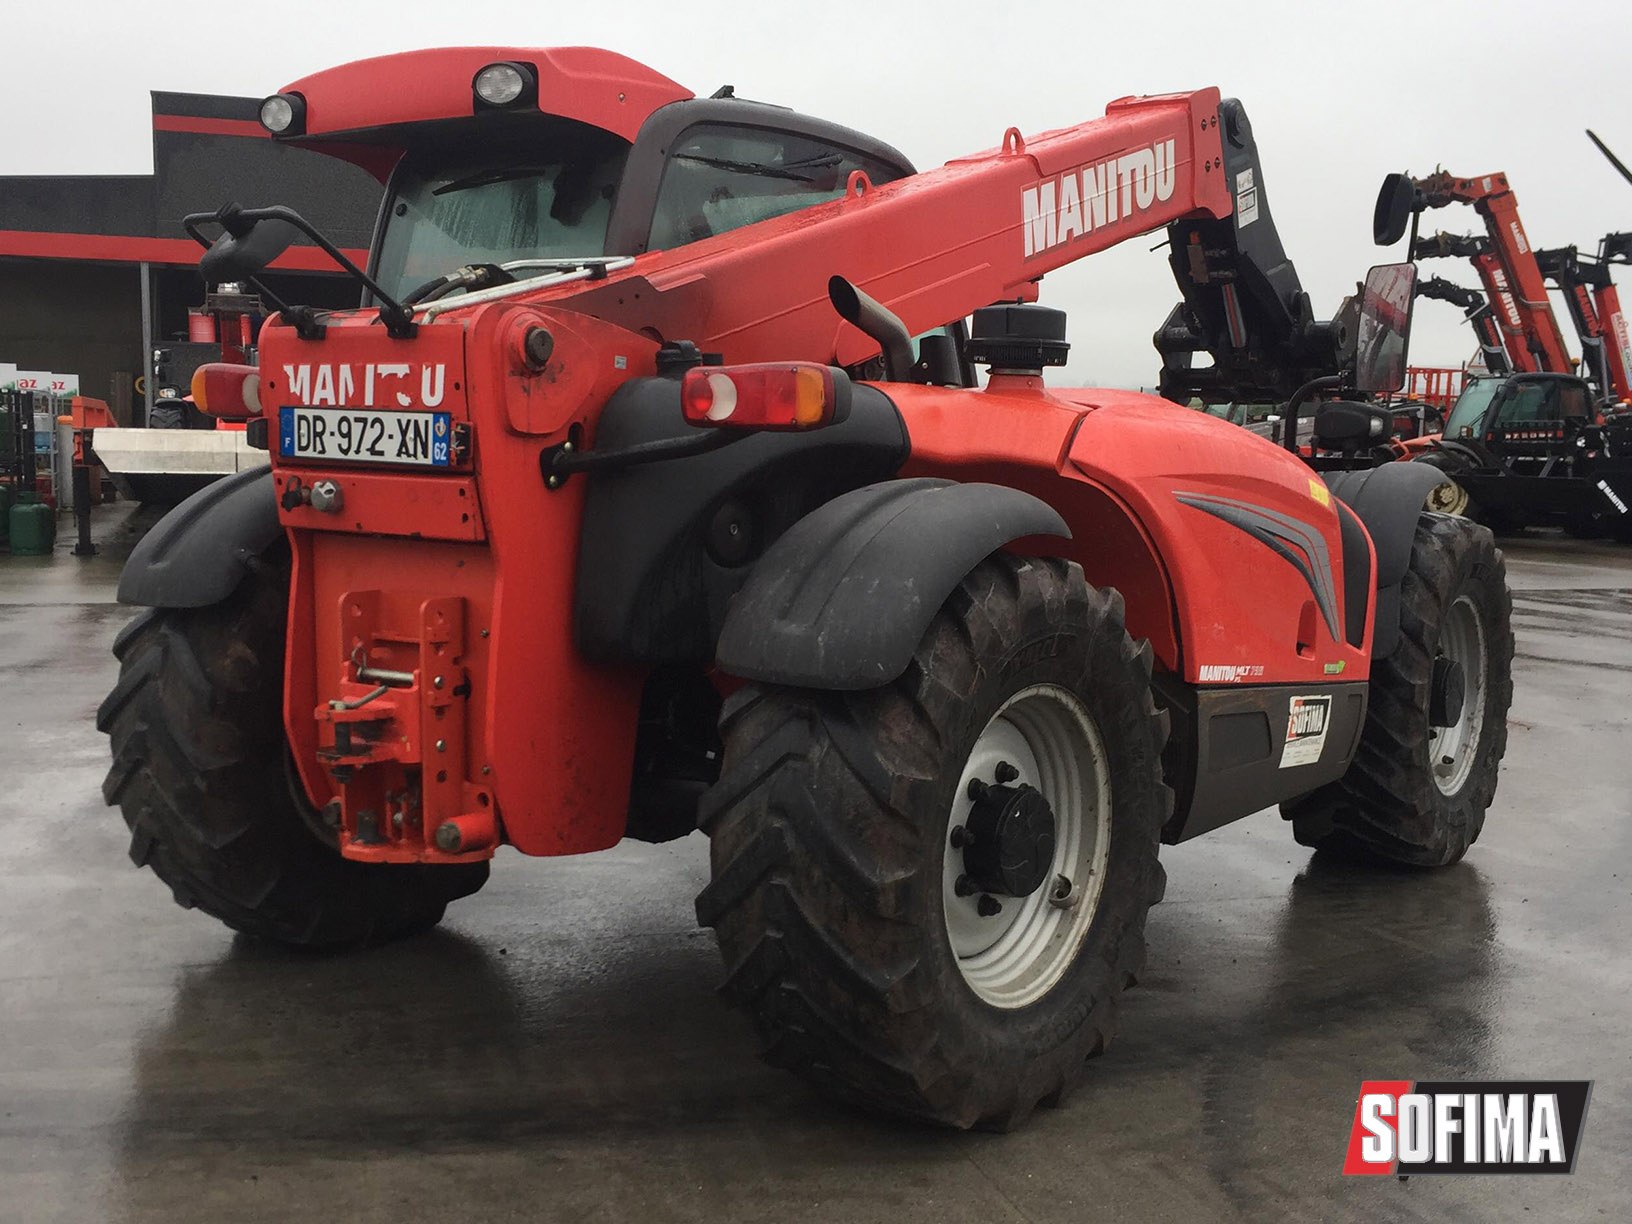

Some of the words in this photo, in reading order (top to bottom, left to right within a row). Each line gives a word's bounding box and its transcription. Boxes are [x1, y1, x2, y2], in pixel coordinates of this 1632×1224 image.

[1022, 138, 1175, 258] MANITOU
[16, 378, 38, 389] az
[284, 436, 292, 448] F
[296, 414, 430, 460] DR-972-XN
[433, 441, 448, 461] 62
[1602, 485, 1629, 514] MANITOU
[1199, 665, 1237, 682] MANITOU
[1291, 704, 1325, 734] SOFIMA
